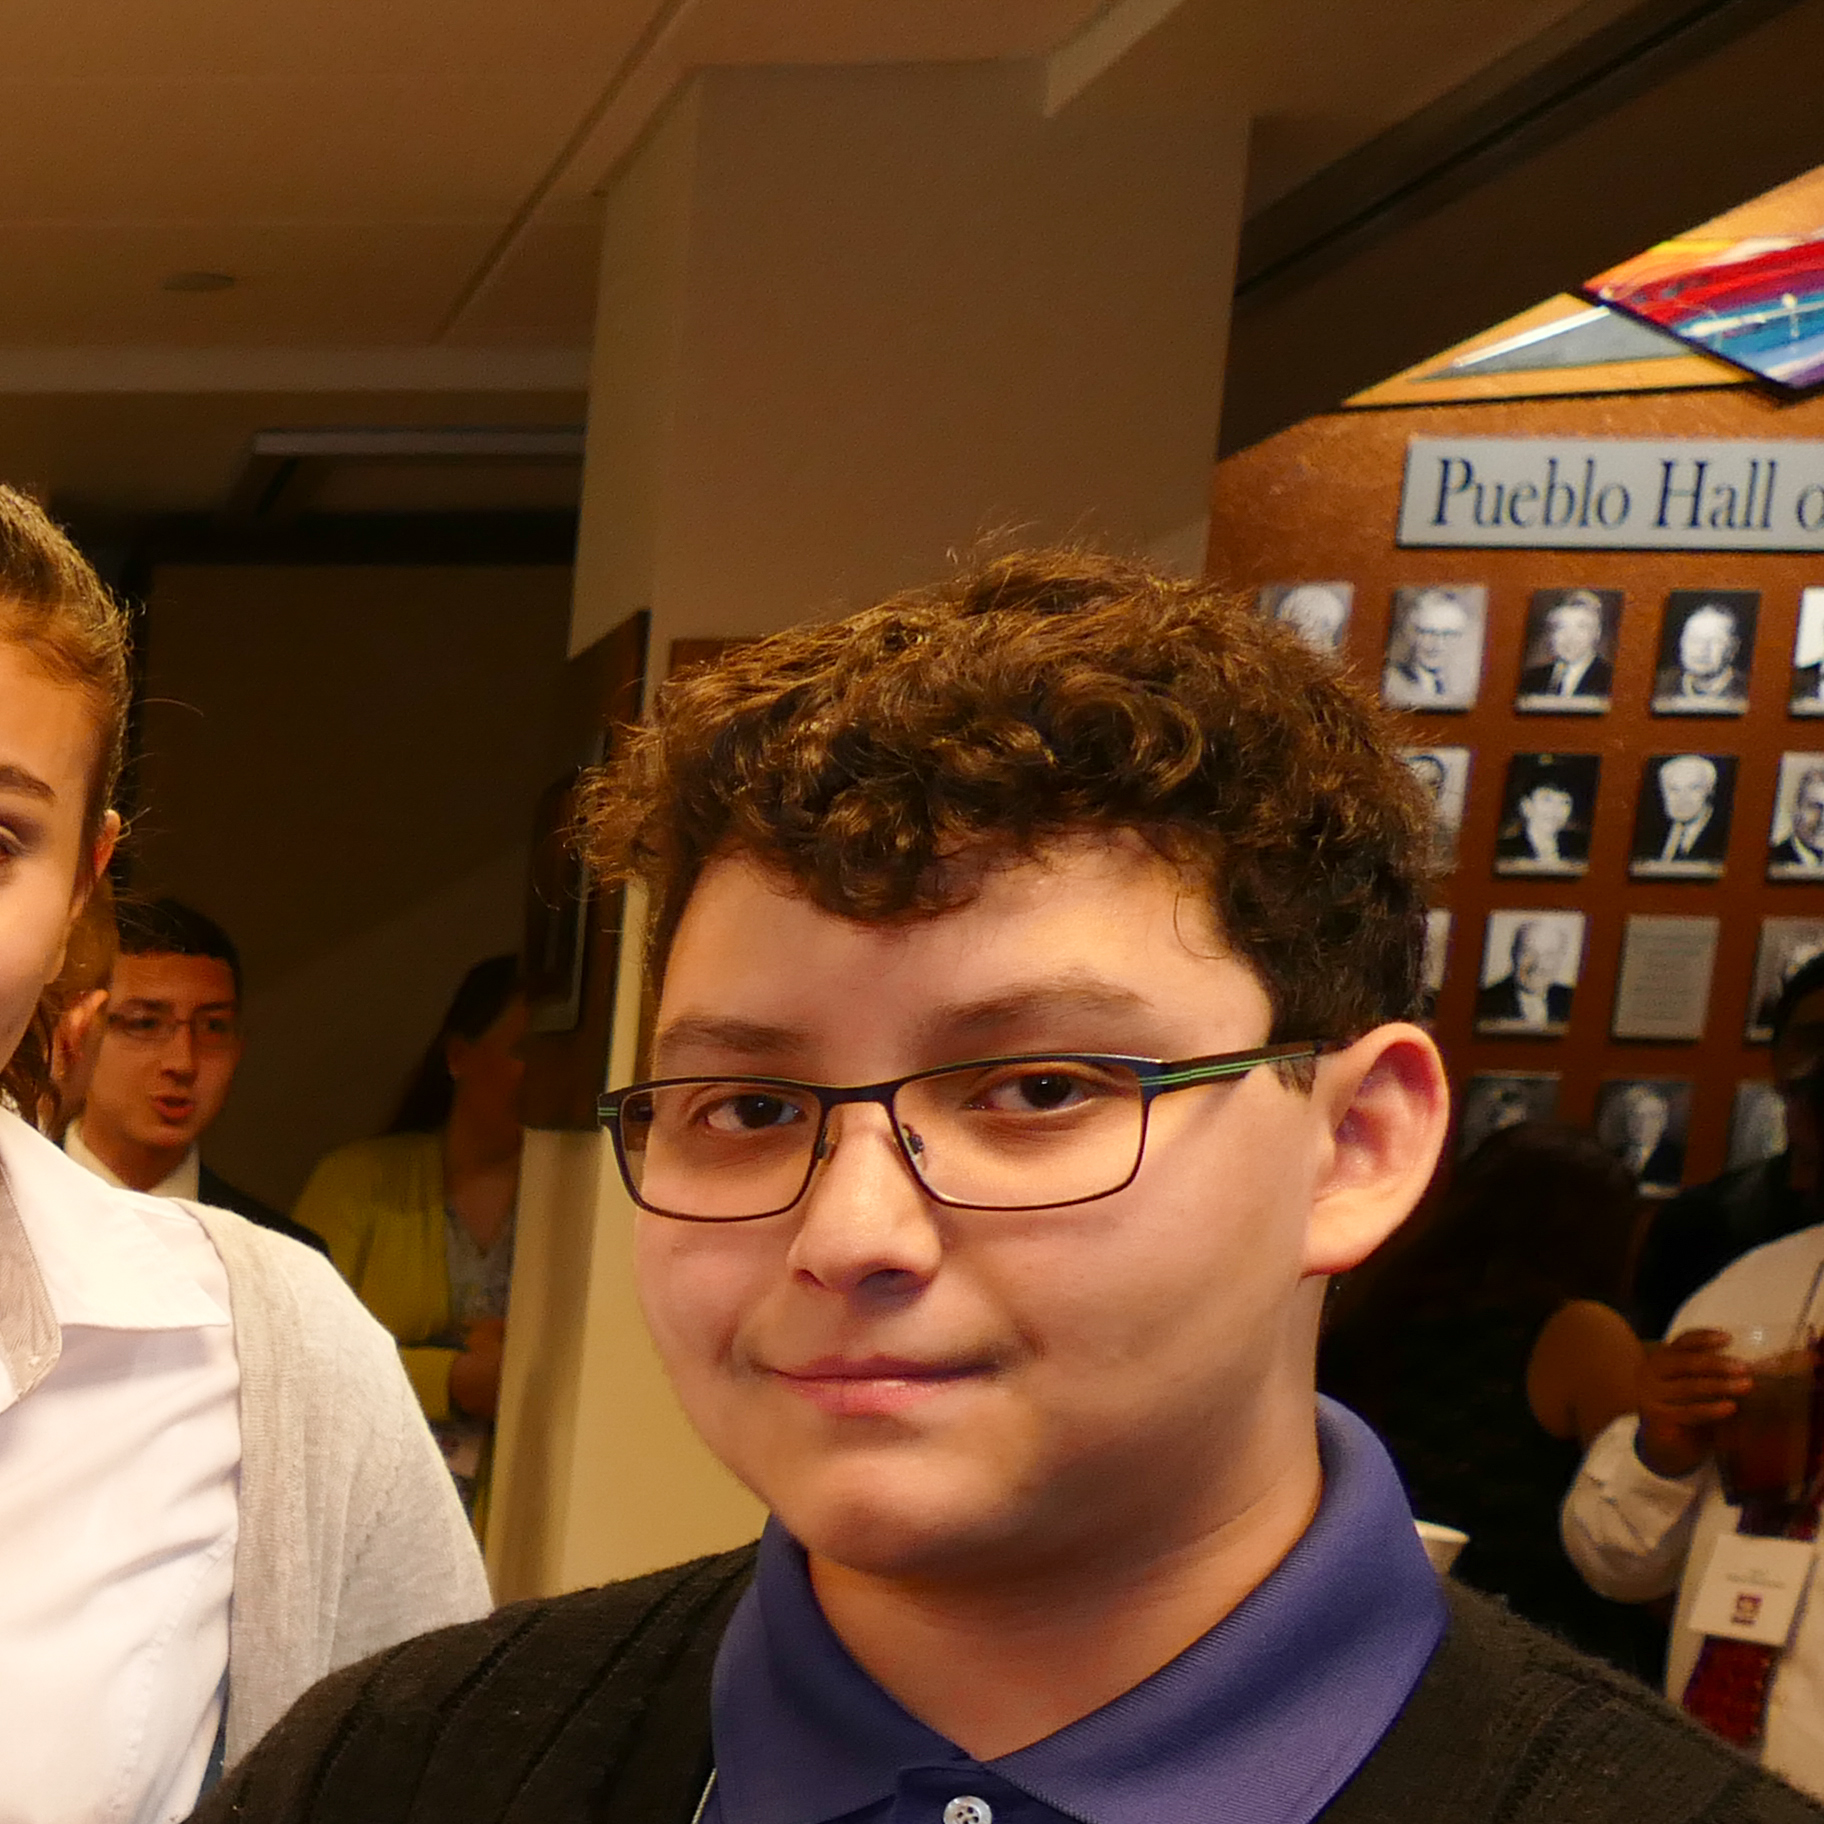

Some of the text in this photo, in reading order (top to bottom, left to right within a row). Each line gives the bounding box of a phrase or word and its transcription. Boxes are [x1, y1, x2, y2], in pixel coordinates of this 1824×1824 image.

[1430, 456, 1824, 531] Pueblo Hall o
